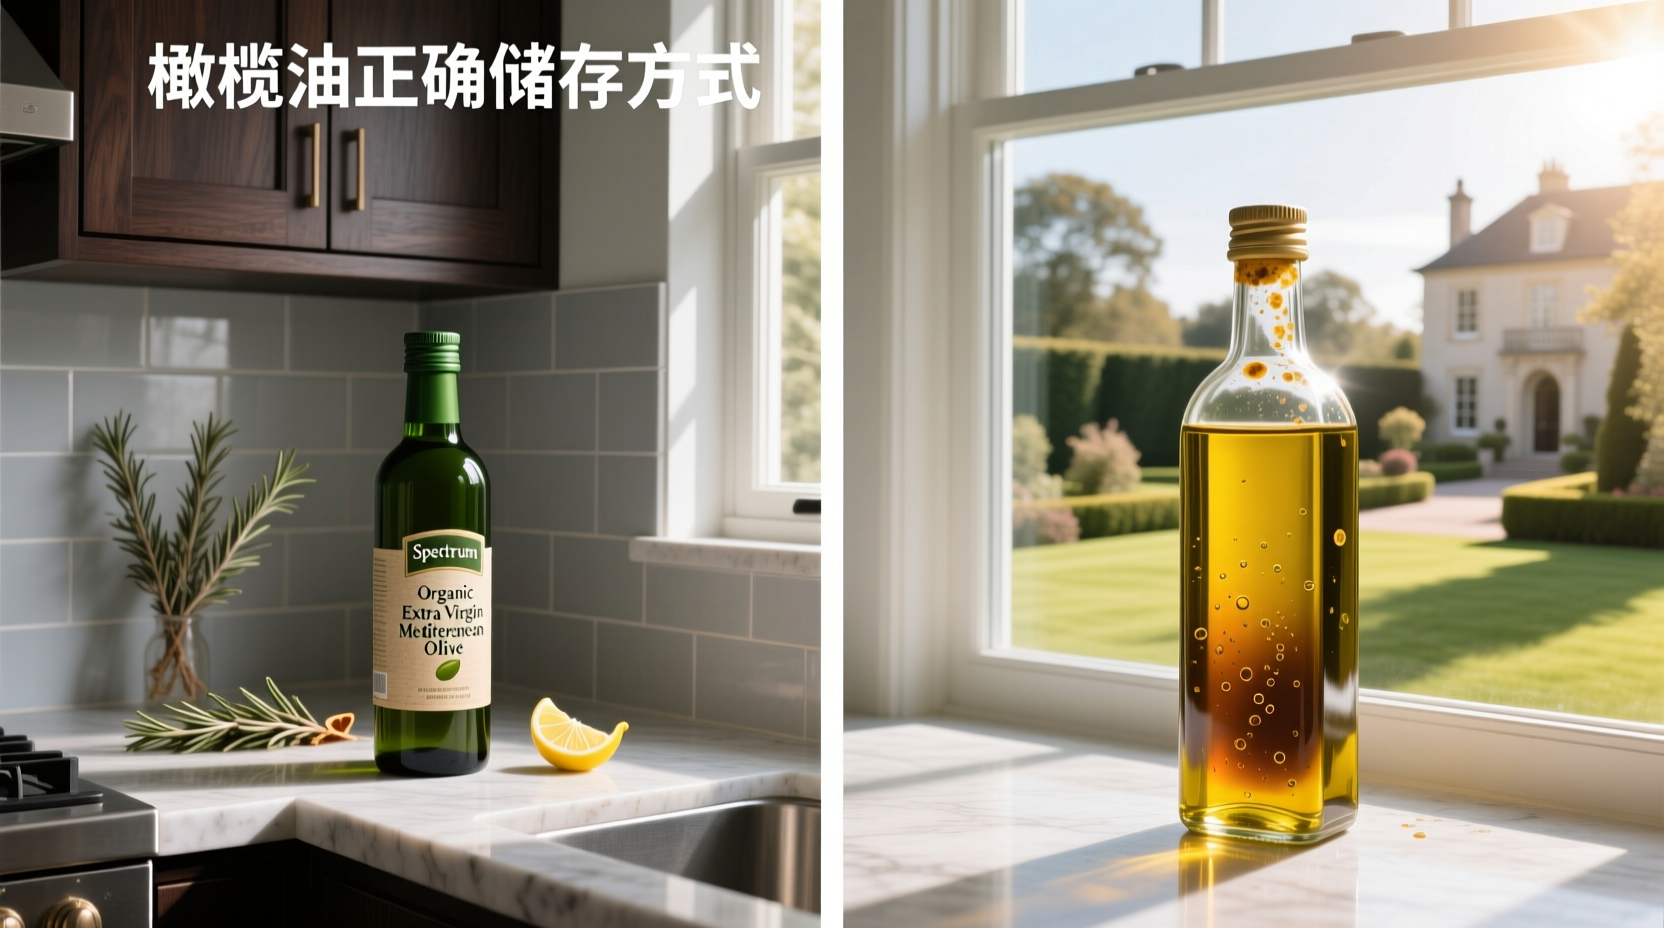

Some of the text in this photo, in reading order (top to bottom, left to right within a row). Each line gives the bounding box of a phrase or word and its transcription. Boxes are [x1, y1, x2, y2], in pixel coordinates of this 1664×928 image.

[413, 544, 478, 563] Spectrum
[418, 585, 474, 604] Organic
[402, 604, 484, 623] Extra Virgin
[424, 640, 464, 656] Olive
